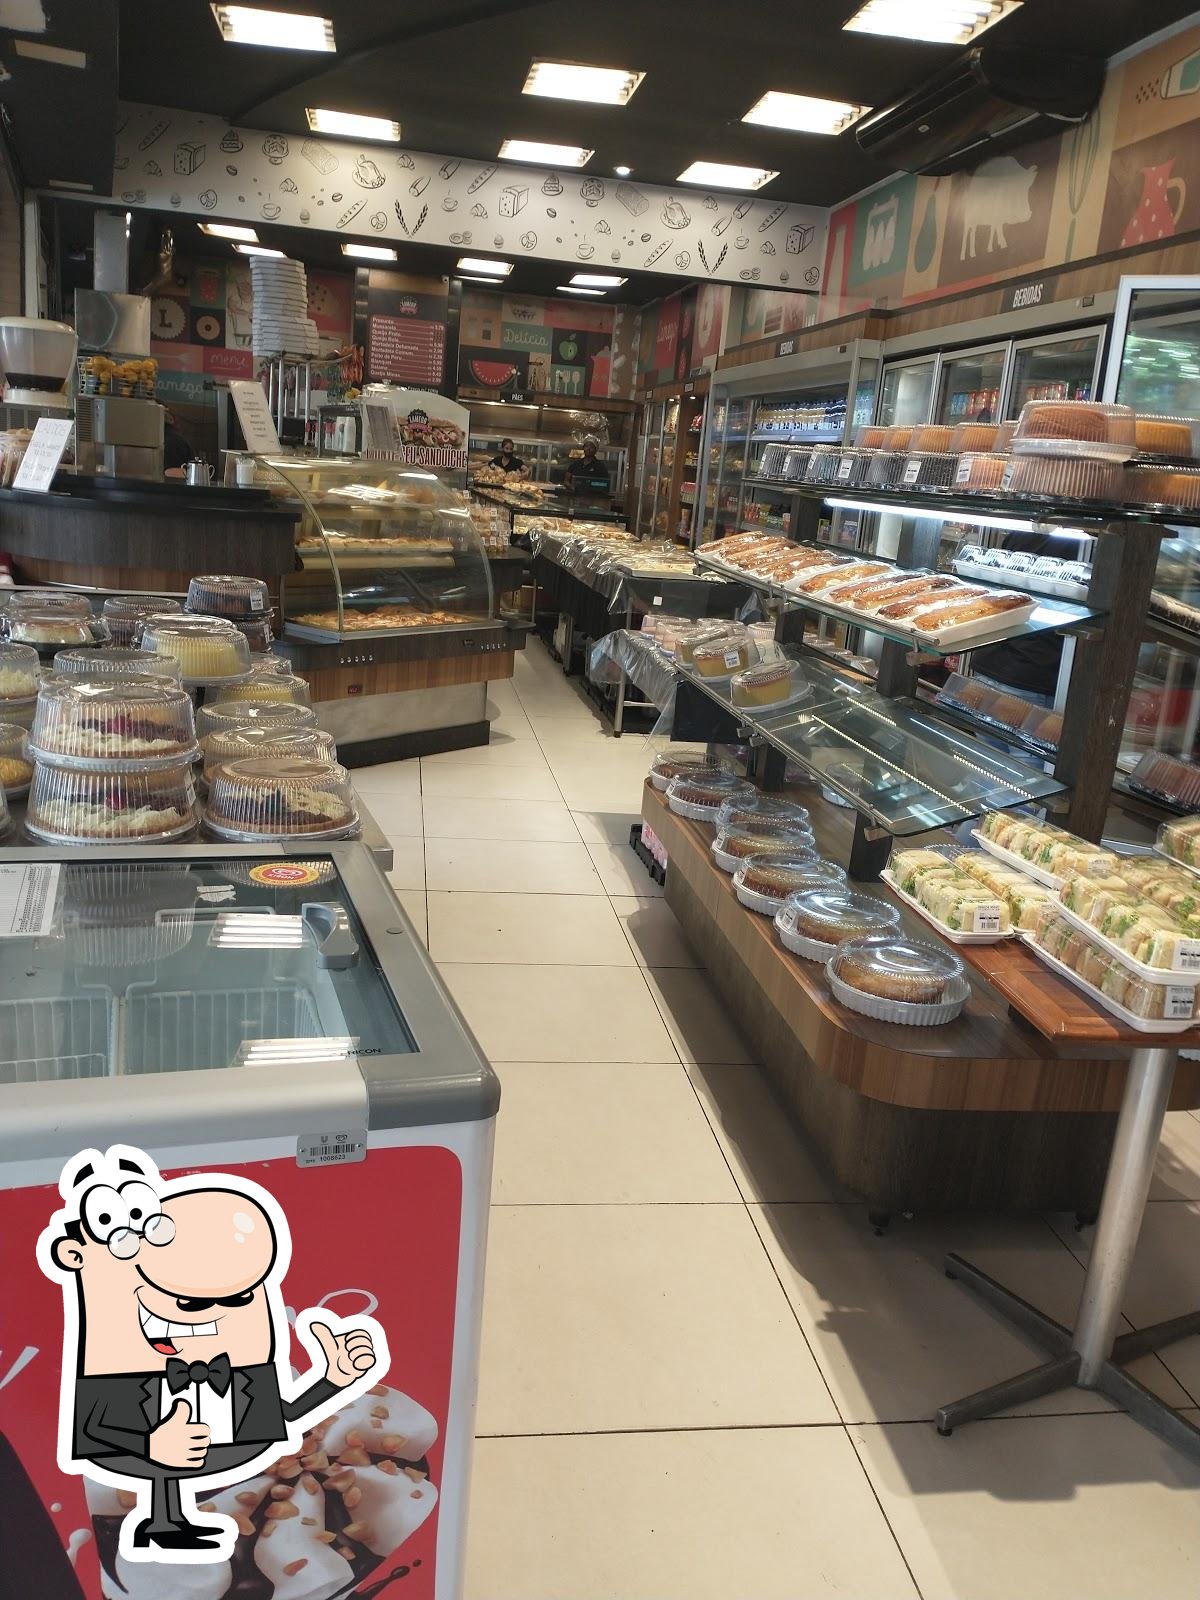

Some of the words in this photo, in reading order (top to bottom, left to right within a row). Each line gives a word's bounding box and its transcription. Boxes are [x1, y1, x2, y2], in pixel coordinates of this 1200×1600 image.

[1012, 284, 1044, 308] BEBIDAS
[158, 309, 172, 328] L
[401, 444, 416, 466] SEU
